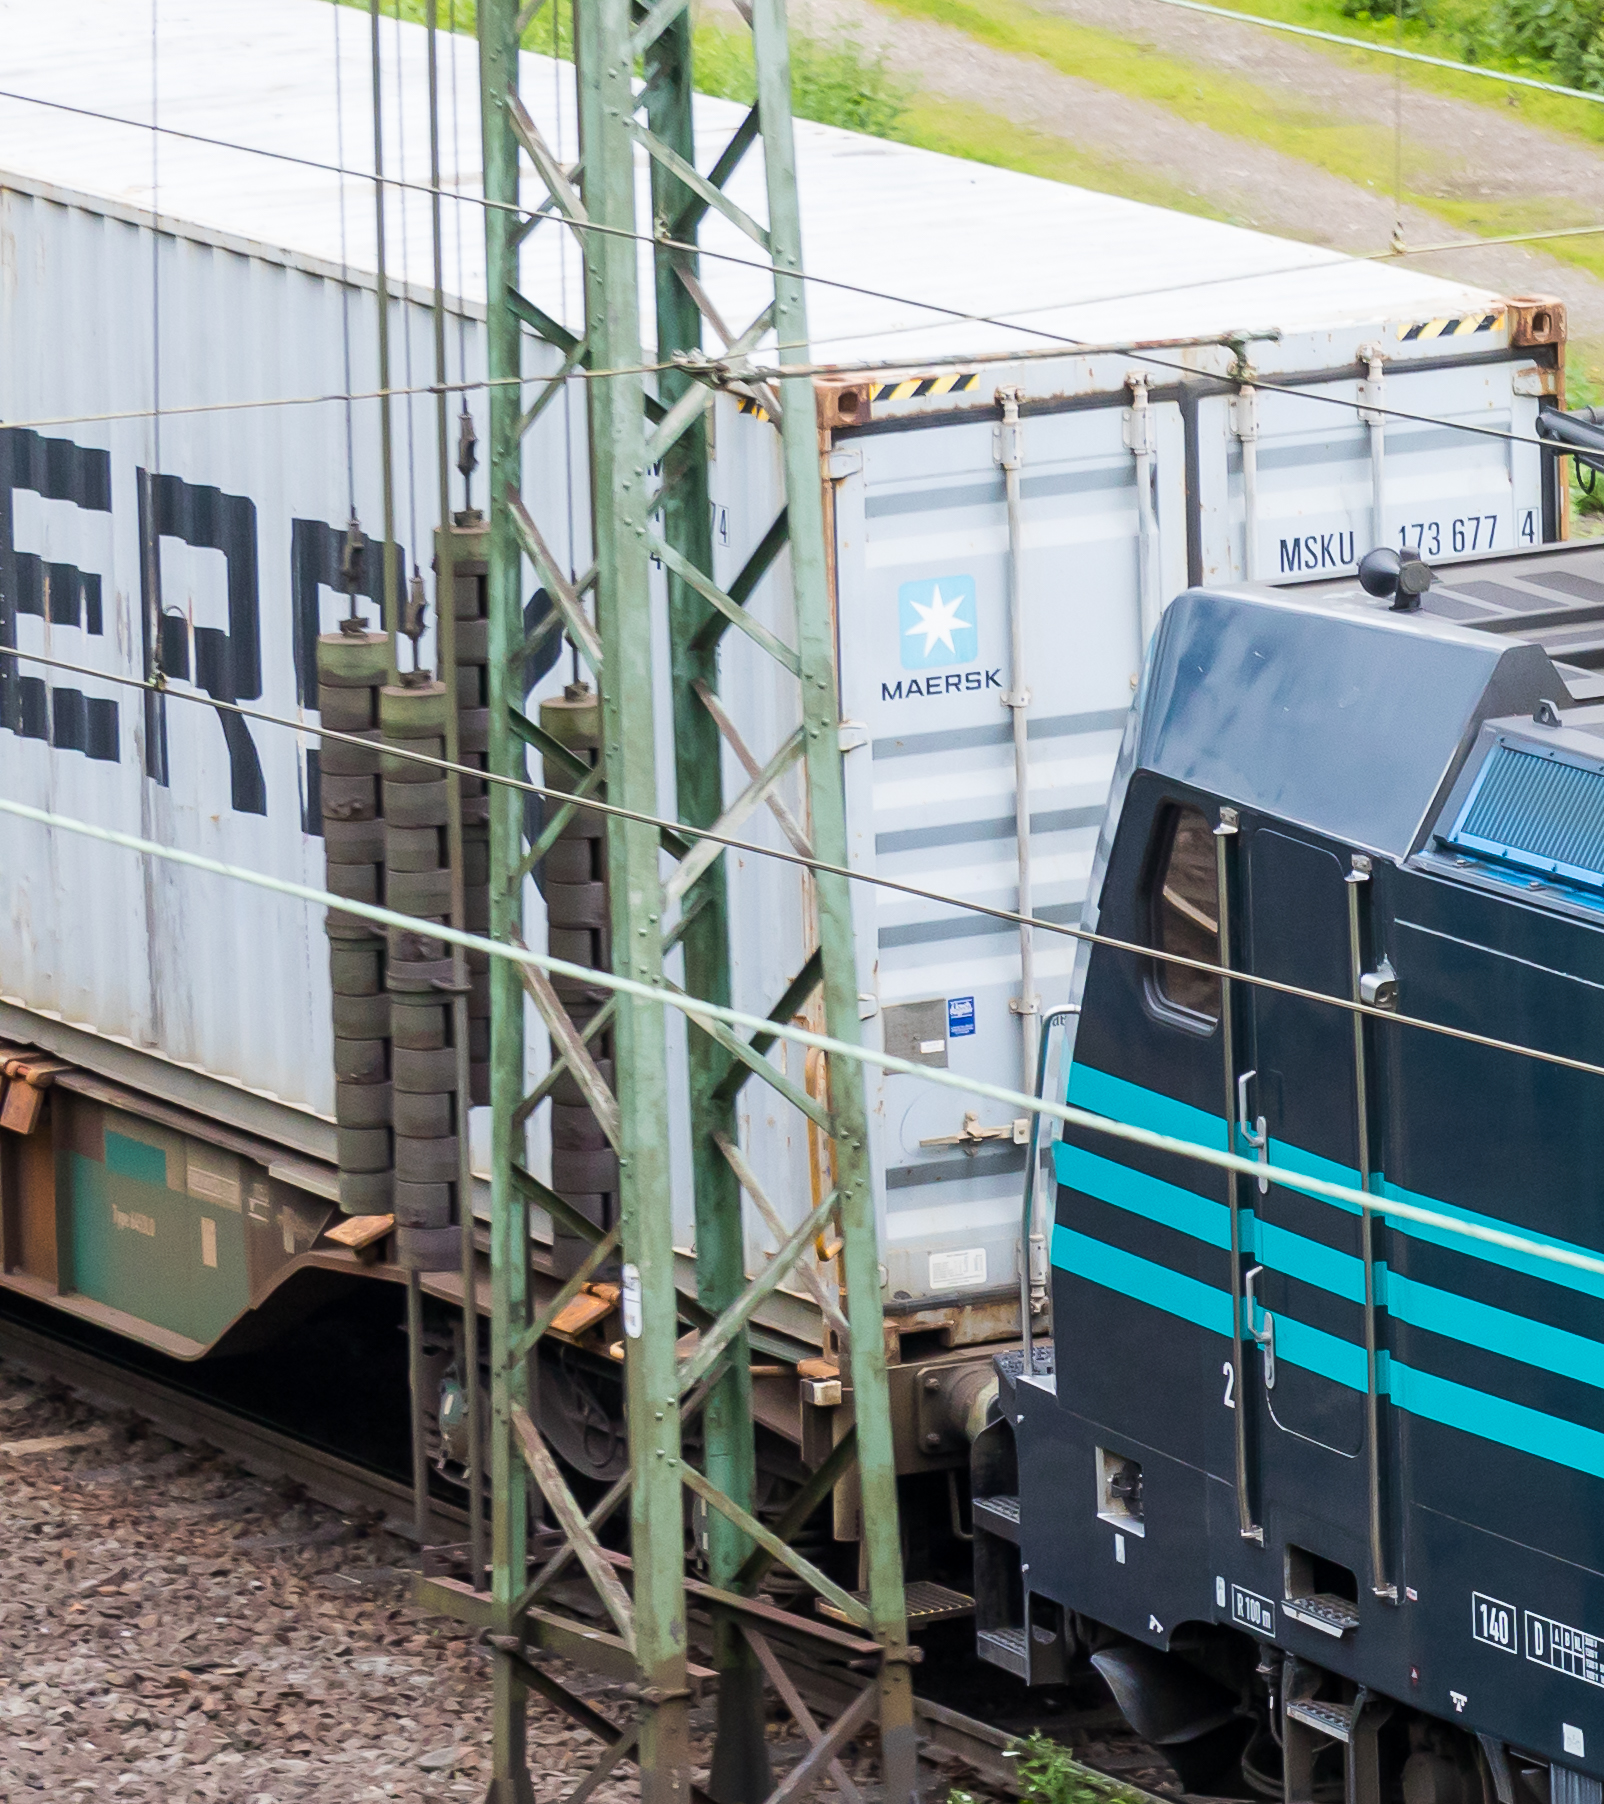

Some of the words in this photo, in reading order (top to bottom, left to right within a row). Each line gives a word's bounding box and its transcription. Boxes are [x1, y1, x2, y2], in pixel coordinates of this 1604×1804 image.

[1279, 531, 1355, 573] MSKU
[1398, 521, 1441, 556] 173
[1452, 514, 1498, 553] 677
[1520, 510, 1535, 544] 4
[881, 668, 1003, 702] MAERSK
[1222, 1361, 1236, 1408] 2
[1236, 1592, 1245, 1617] R
[1244, 1597, 1261, 1625] 100
[1479, 1603, 1509, 1645] 140
[1533, 1620, 1544, 1656] D
